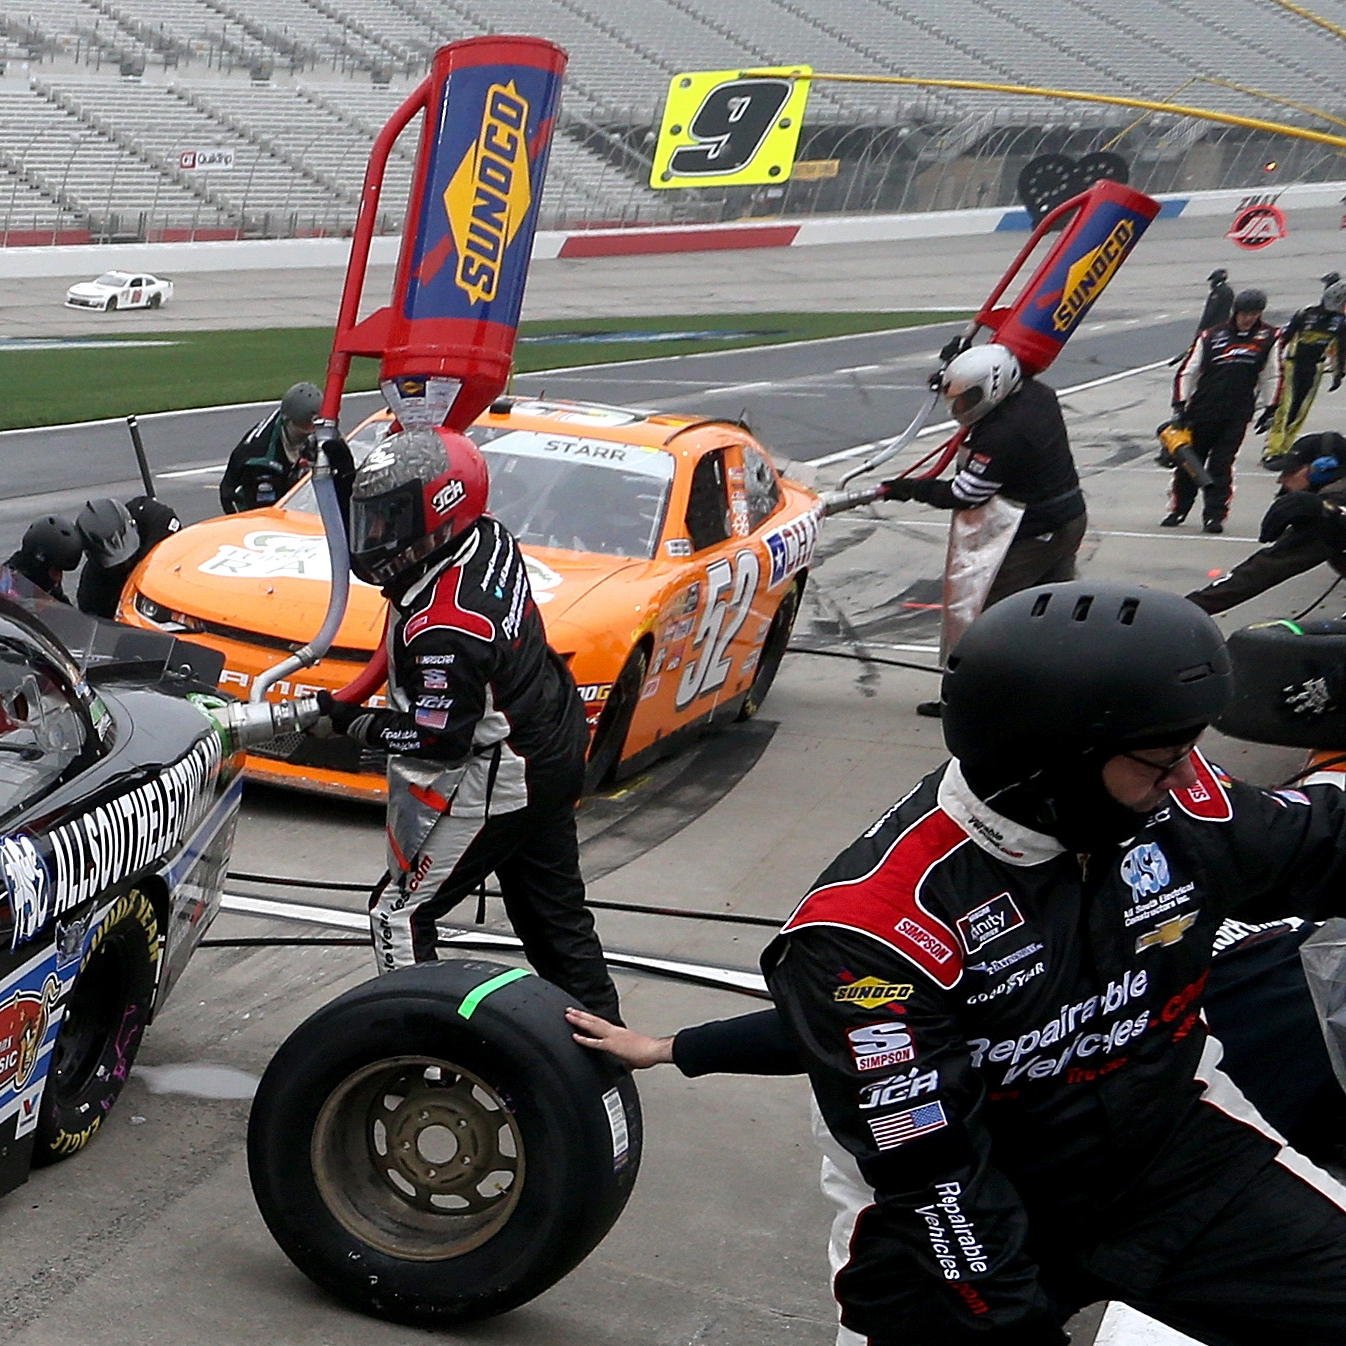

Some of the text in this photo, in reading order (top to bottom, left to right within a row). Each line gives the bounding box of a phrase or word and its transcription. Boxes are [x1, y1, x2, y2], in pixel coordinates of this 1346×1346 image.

[670, 78, 793, 177] 9
[461, 88, 528, 298] SUNOCO
[1054, 221, 1132, 330] SUNOCO
[544, 439, 627, 462] STARR
[676, 549, 760, 711] 52
[897, 920, 952, 962] SIMPSON
[1136, 898, 1158, 915] South
[1159, 881, 1196, 904] Electrical
[835, 985, 912, 1000] SUNOCO
[965, 969, 1149, 1068] Repairable
[858, 1050, 912, 1070] SIMPSON
[914, 1204, 990, 1315] Vehicles.com
[935, 1181, 988, 1273] Repairable
